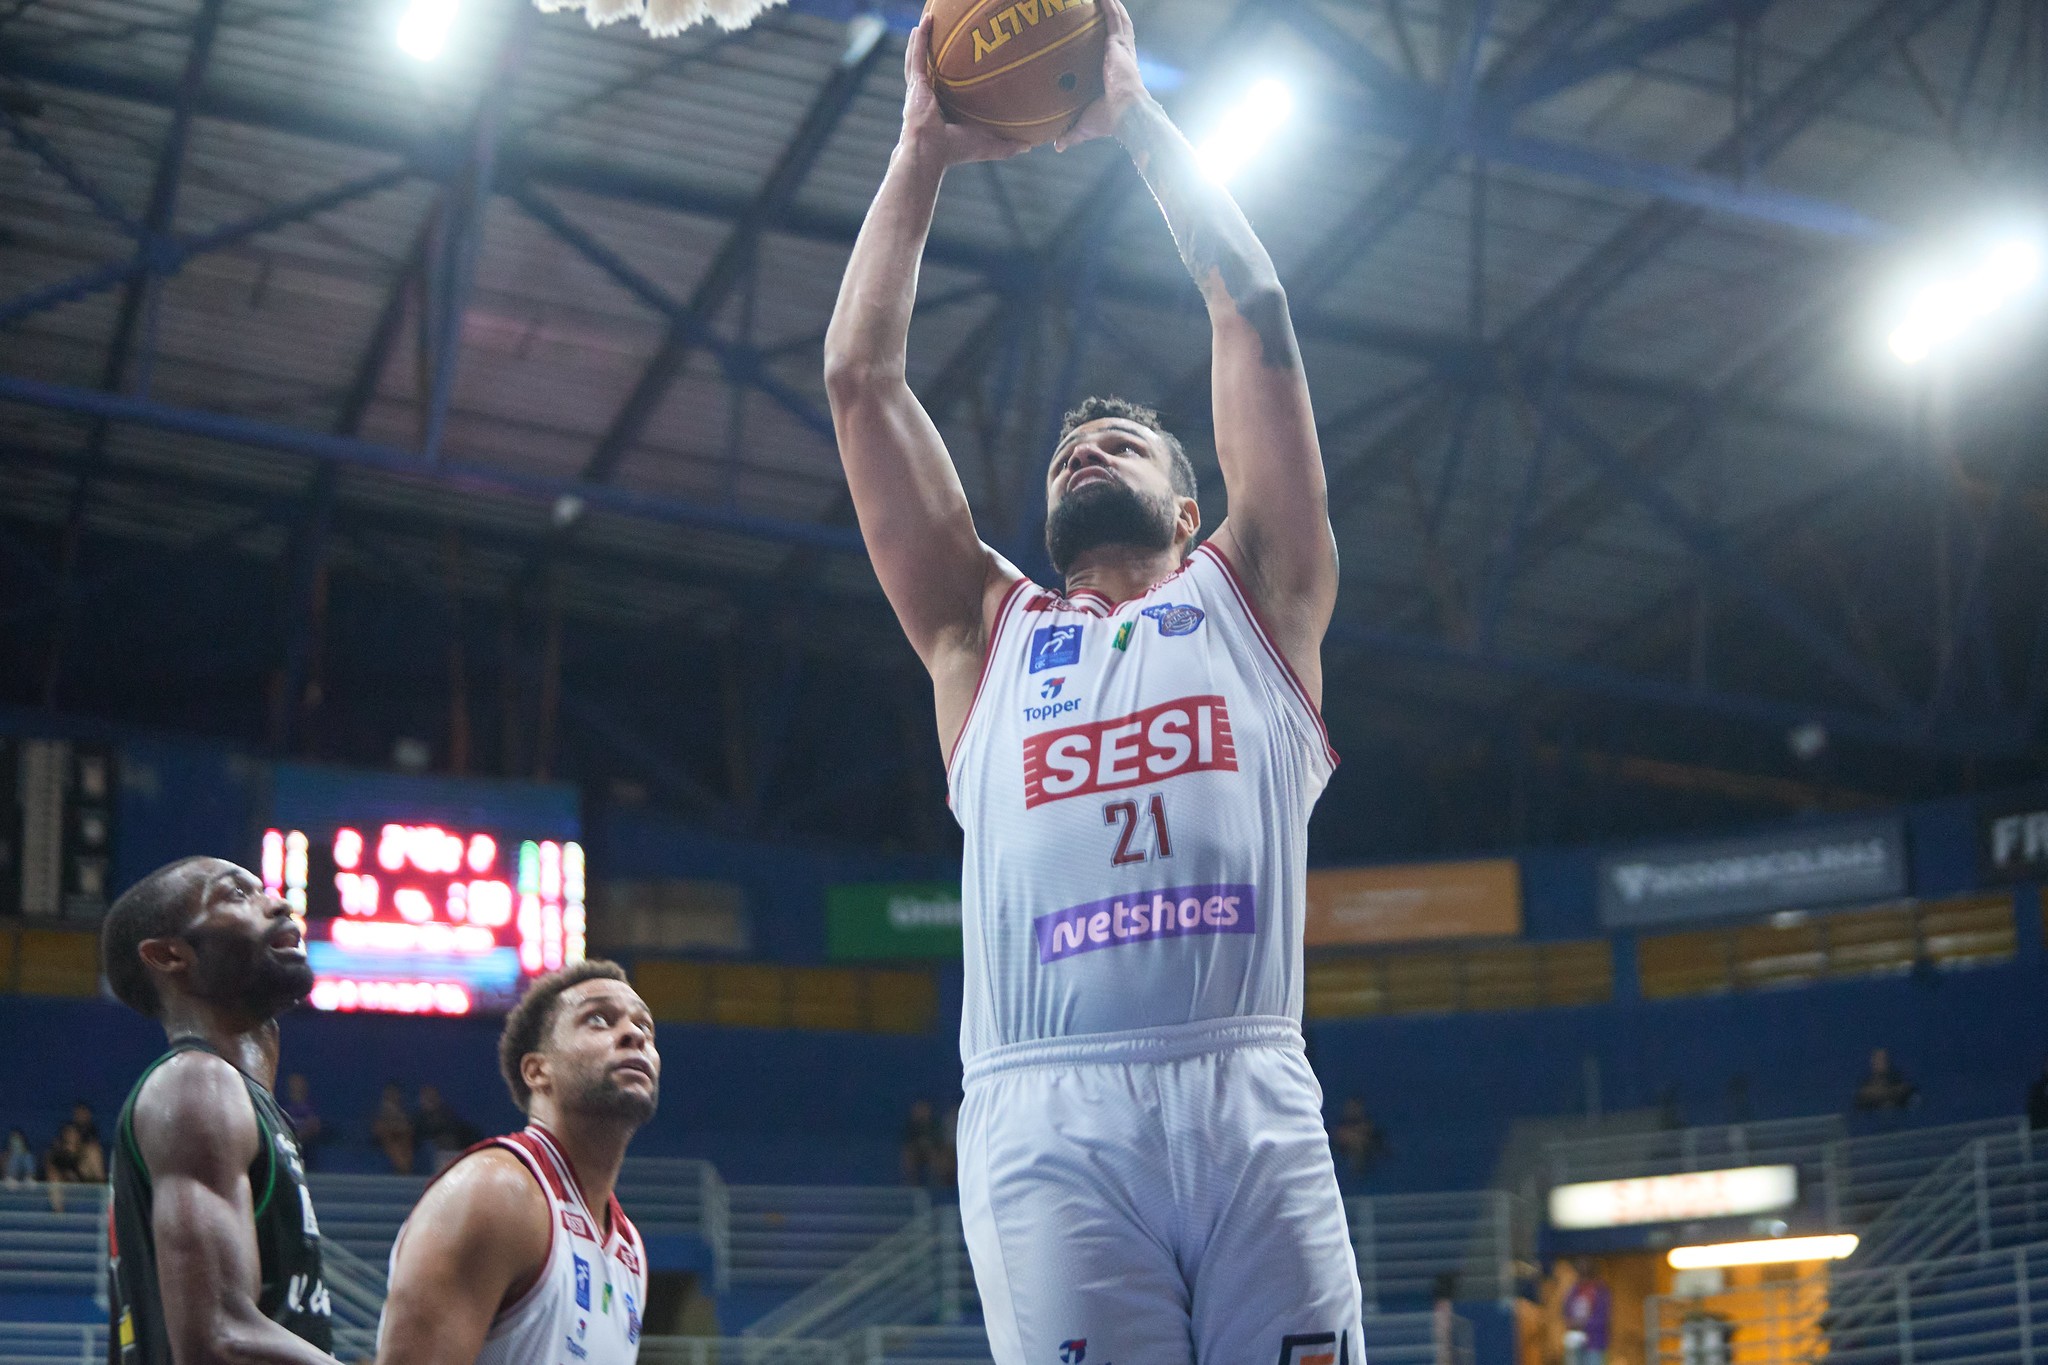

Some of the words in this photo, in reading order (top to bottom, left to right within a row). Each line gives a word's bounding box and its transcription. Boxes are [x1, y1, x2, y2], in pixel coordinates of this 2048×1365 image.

[1023, 698, 1082, 722] Topper
[1042, 705, 1213, 794] SESI
[1103, 792, 1174, 868] 21
